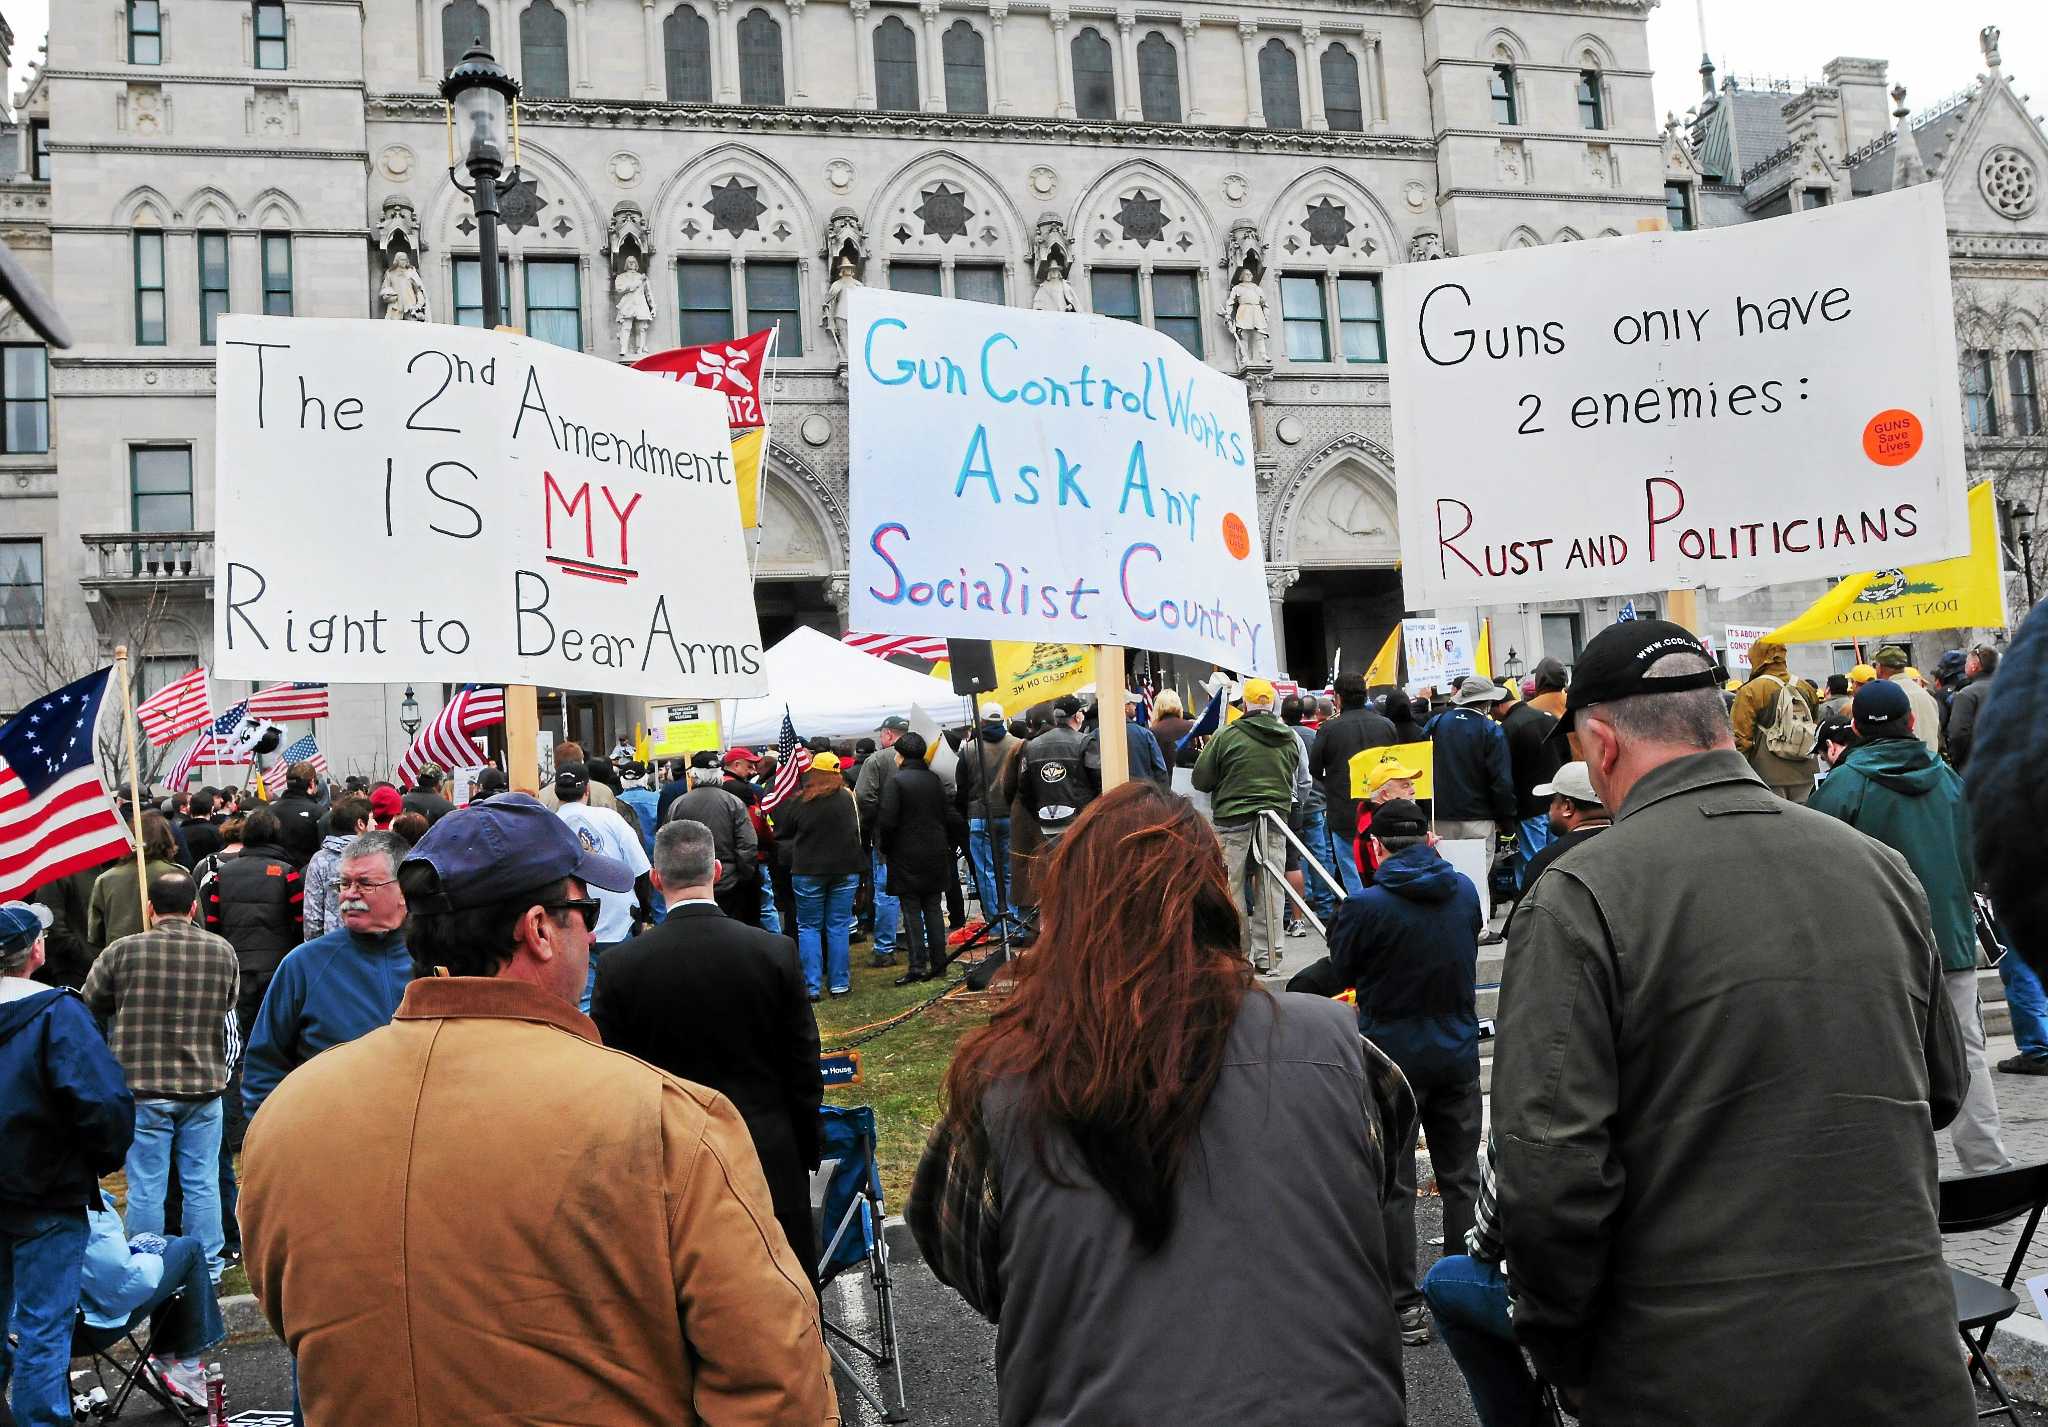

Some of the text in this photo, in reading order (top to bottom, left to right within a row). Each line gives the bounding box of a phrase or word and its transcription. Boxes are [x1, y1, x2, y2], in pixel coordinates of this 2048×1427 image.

[1418, 283, 1853, 367] Guns only have
[225, 340, 732, 485] The 2nd Amendment
[864, 317, 1247, 467] Gun Control Works
[1517, 376, 1809, 435] 2 enemies:
[1874, 418, 1910, 434] GUNS
[1879, 432, 1908, 444] Save
[954, 423, 1201, 542] Ask Any
[1878, 441, 1911, 454] Lives
[385, 457, 642, 565] IS MY
[1436, 476, 1918, 581] RUST AND POLITICIANS
[226, 562, 760, 675] Right to Bear Arms
[868, 522, 1263, 672] Socialist Country
[1740, 629, 1760, 639] ABOUT
